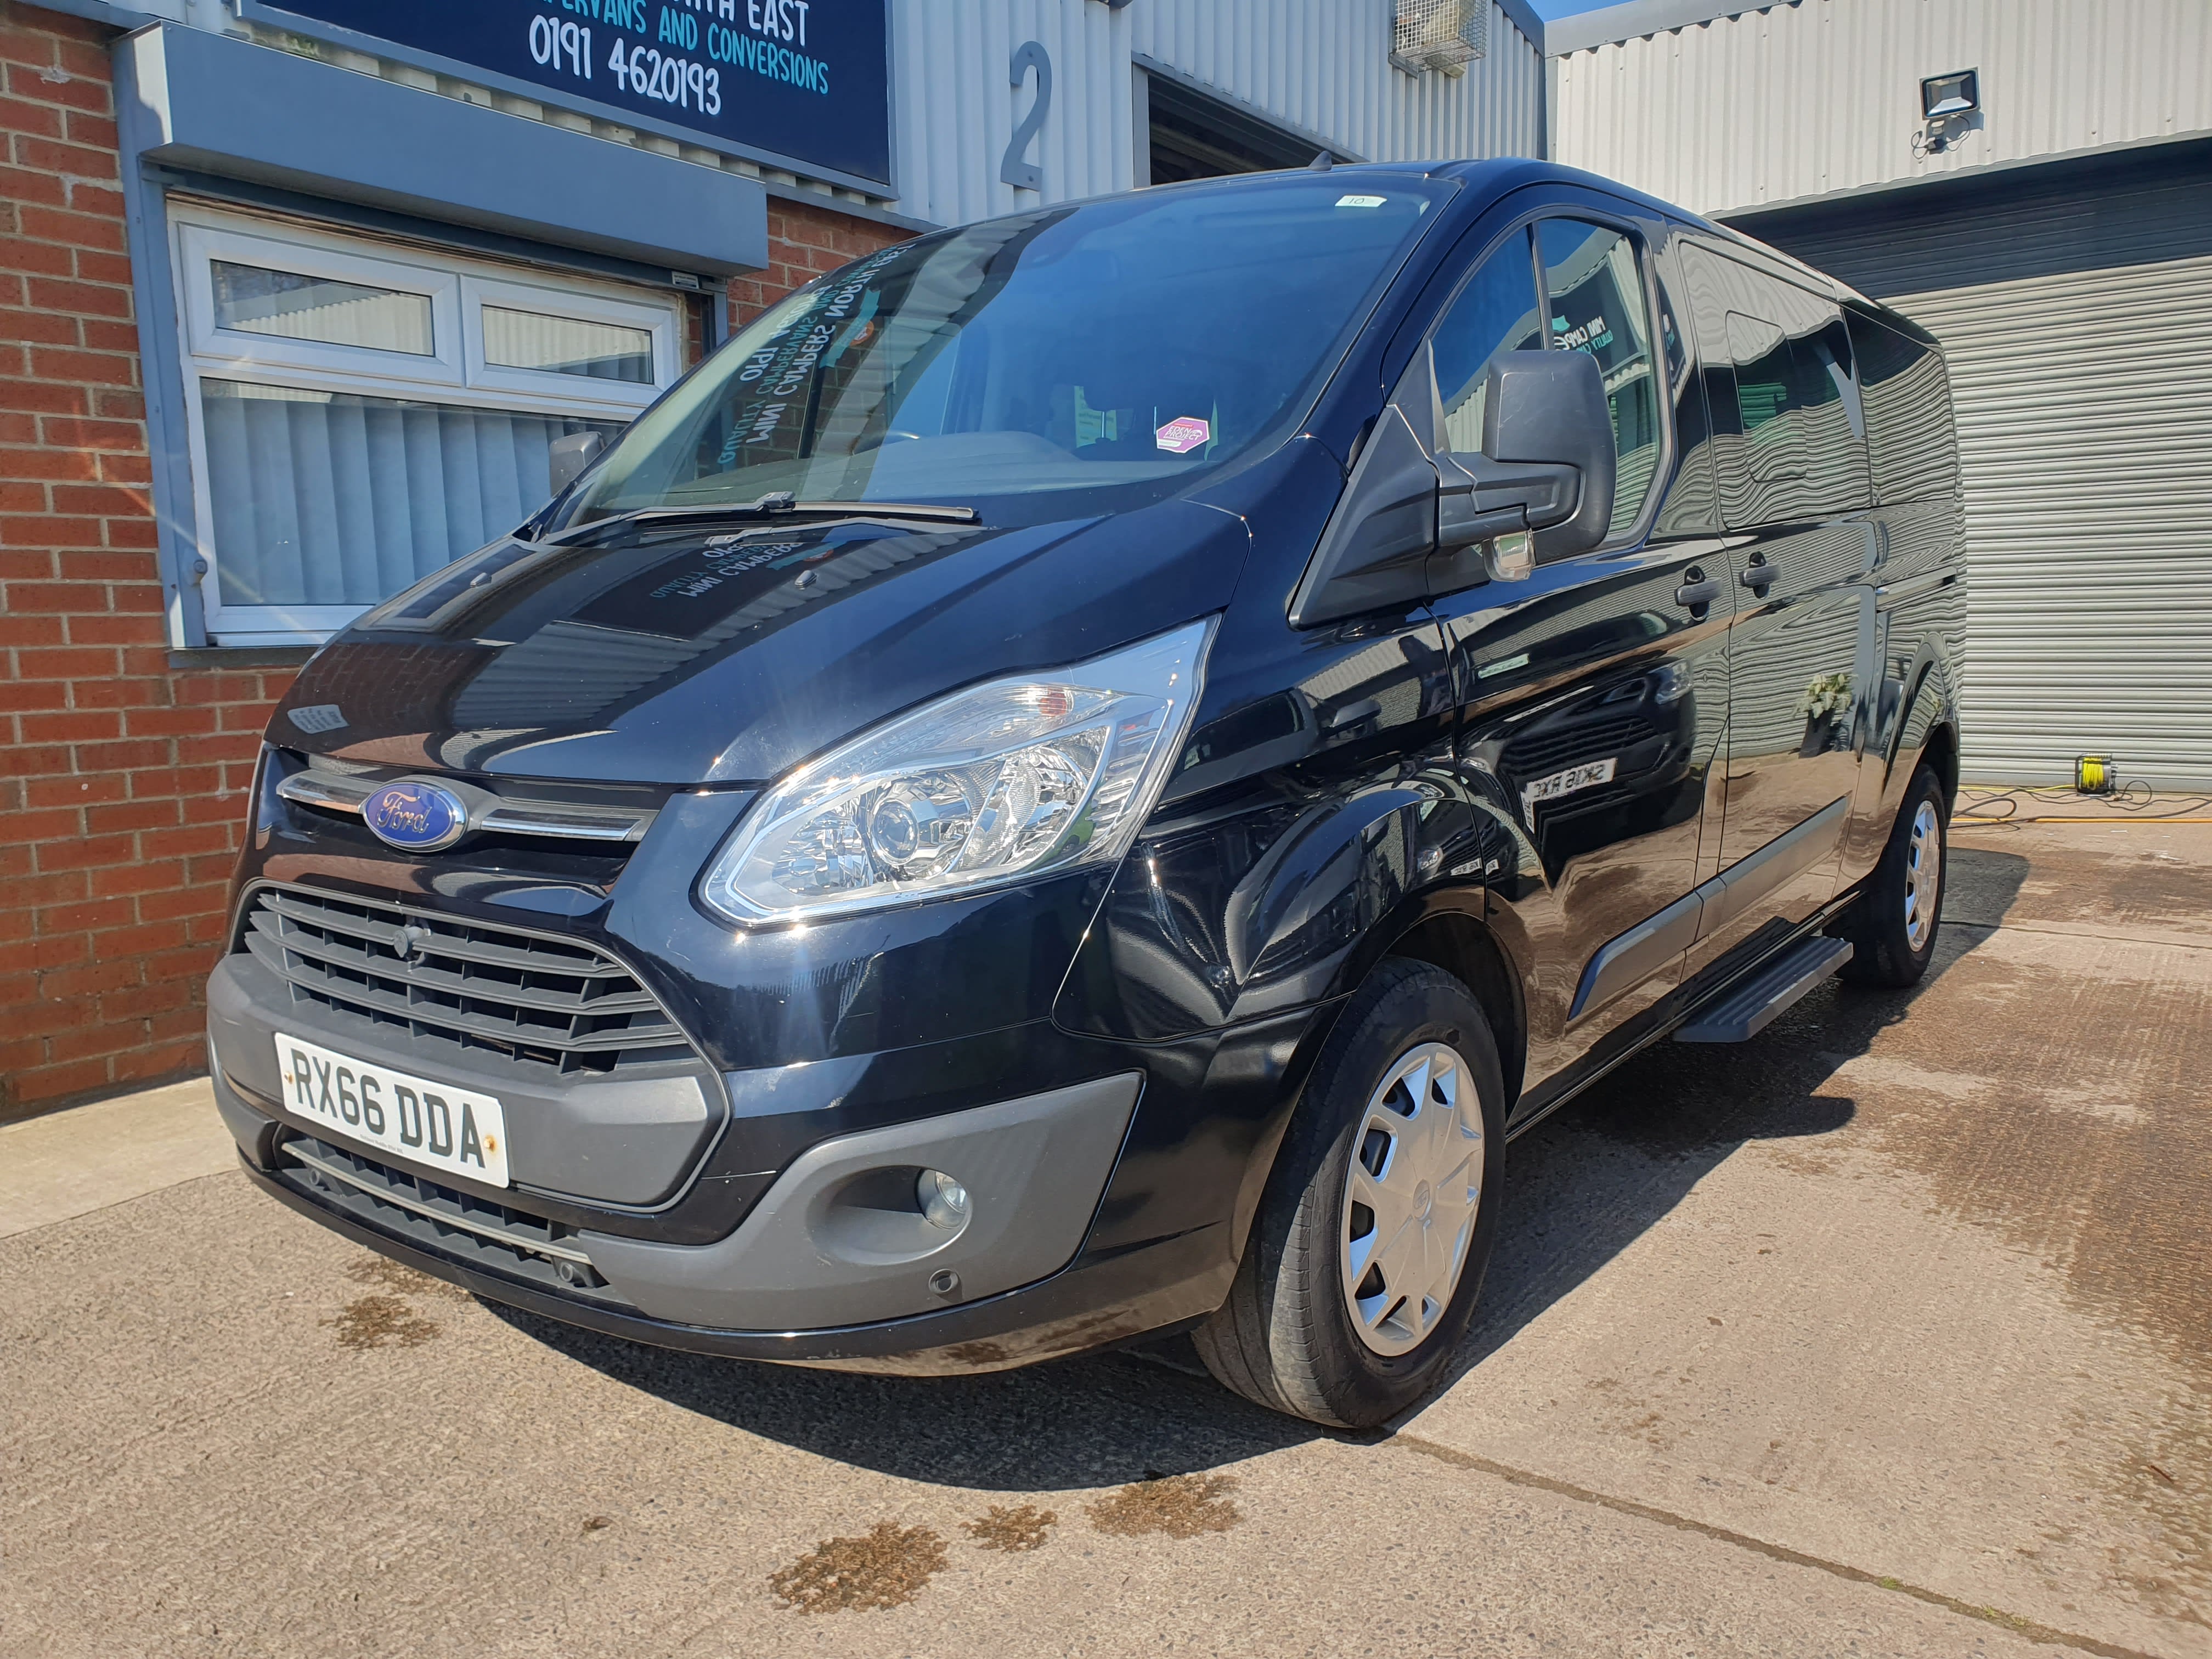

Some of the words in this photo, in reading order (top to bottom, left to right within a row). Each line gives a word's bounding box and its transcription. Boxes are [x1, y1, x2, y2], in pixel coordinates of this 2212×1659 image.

[658, 5, 698, 50] AND
[707, 22, 829, 94] CONVERSIONS
[748, 0, 809, 47] EAST
[529, 14, 591, 80] 0191
[608, 37, 721, 115] 4620193
[1000, 40, 1052, 192] 2
[1164, 431, 1200, 441] PROJECT
[1169, 426, 1192, 435] EDEN
[376, 791, 433, 833] Ford
[290, 1047, 386, 1136] RX66
[394, 1084, 486, 1169] DDA
